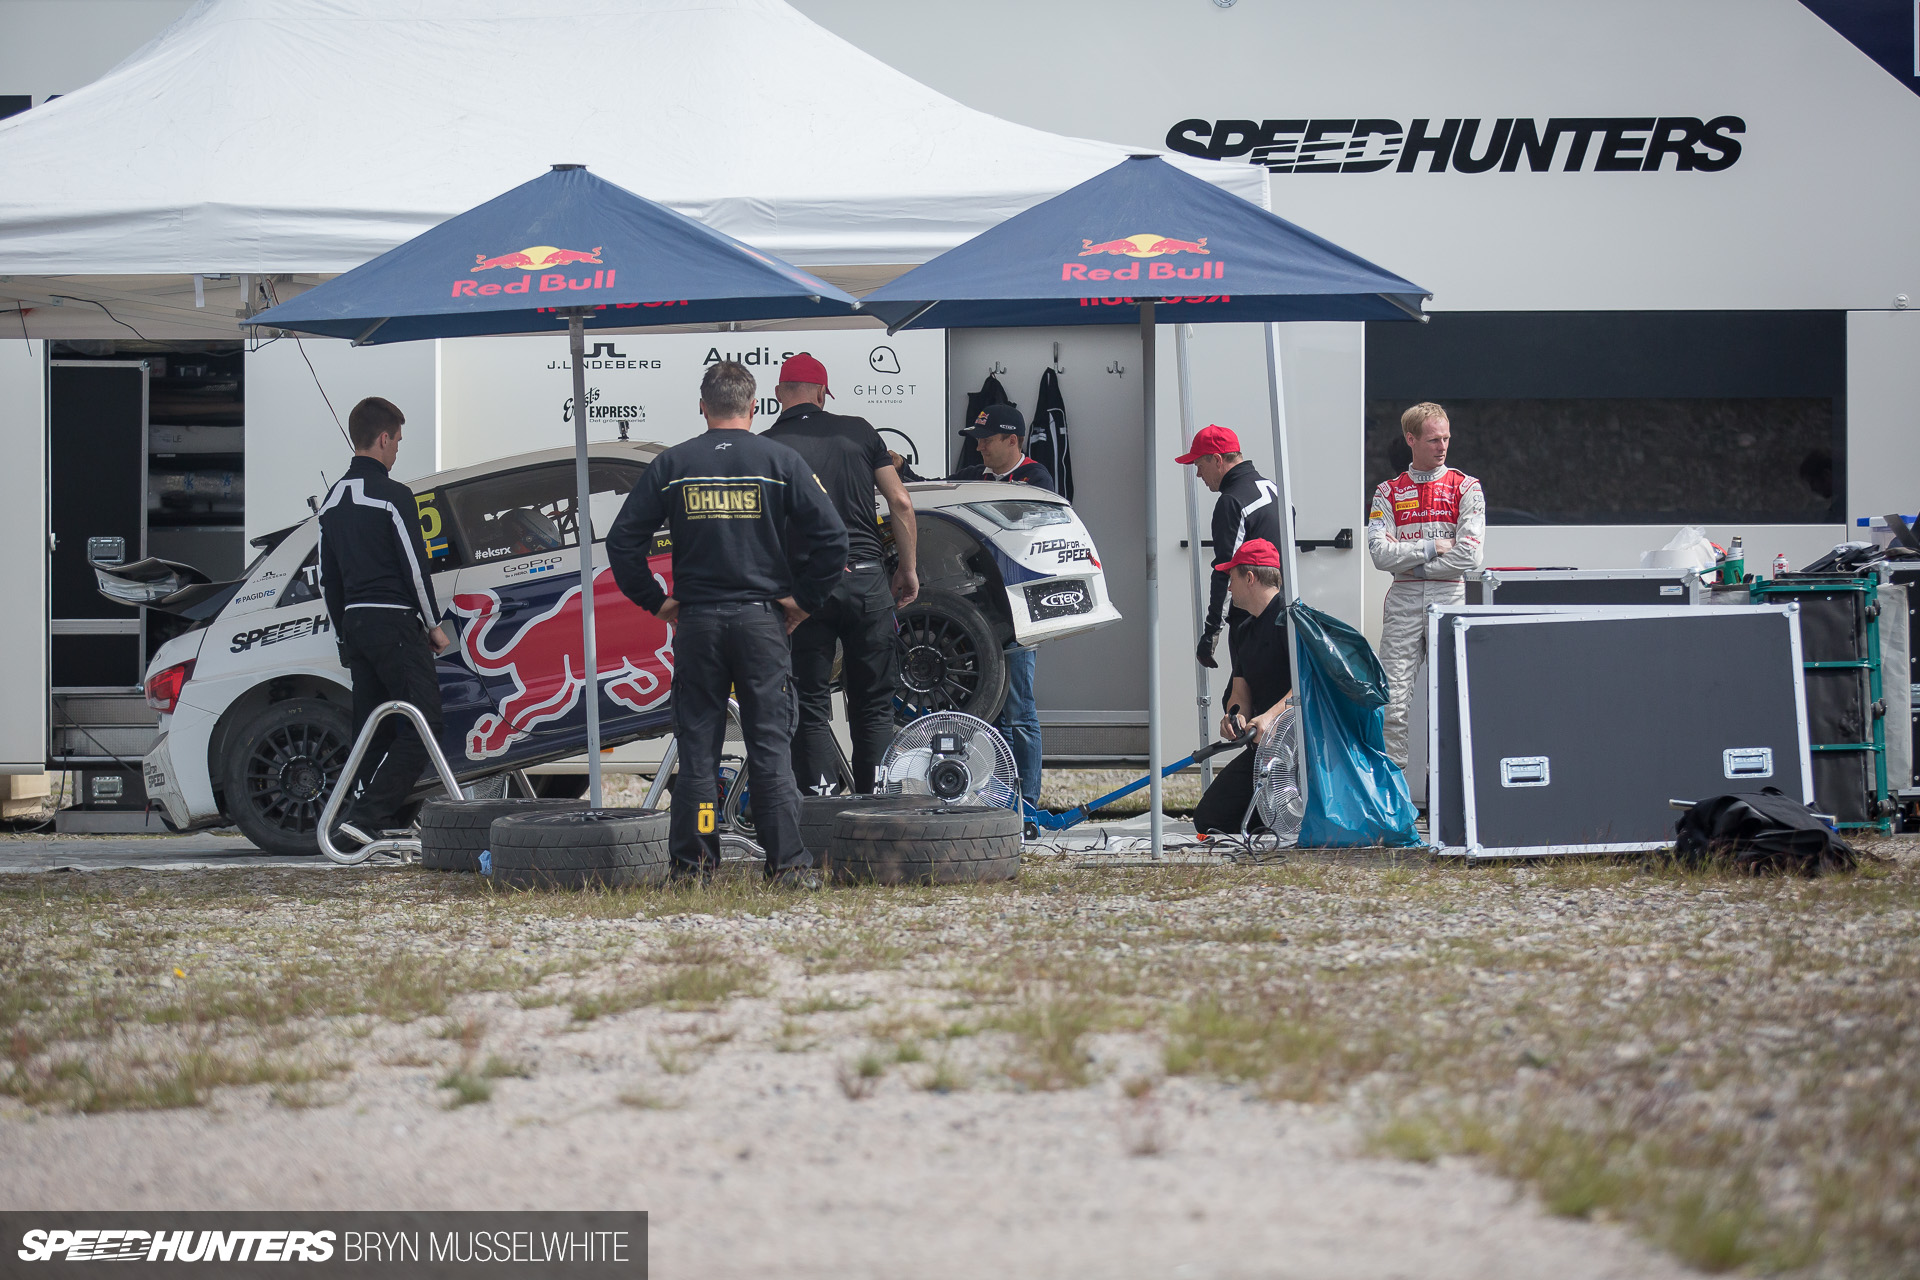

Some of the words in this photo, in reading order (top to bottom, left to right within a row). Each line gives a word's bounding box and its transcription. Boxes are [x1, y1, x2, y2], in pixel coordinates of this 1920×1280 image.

[1165, 115, 1747, 174] SPEEDHUNTERS
[1061, 262, 1140, 281] Red
[1148, 261, 1225, 280] Bull
[451, 275, 531, 298] Red
[539, 269, 616, 292] Bull
[703, 347, 812, 366] Audi.s
[547, 360, 661, 370] J.LNDEBERG
[854, 384, 917, 396] GHOST
[589, 405, 638, 418] EXPRESS
[1395, 484, 1417, 493] TOTAL
[687, 487, 757, 510] ÖHLINS
[414, 492, 442, 541] 5
[1429, 509, 1452, 517] Sport
[1400, 530, 1424, 541] Audi
[1427, 529, 1455, 539] ultra
[474, 545, 512, 560] #eksrx
[1029, 539, 1066, 555] NEED
[1067, 541, 1079, 549] FOR
[503, 556, 562, 573] GoPro
[1050, 592, 1077, 606] CTEK
[697, 802, 715, 834] Ö
